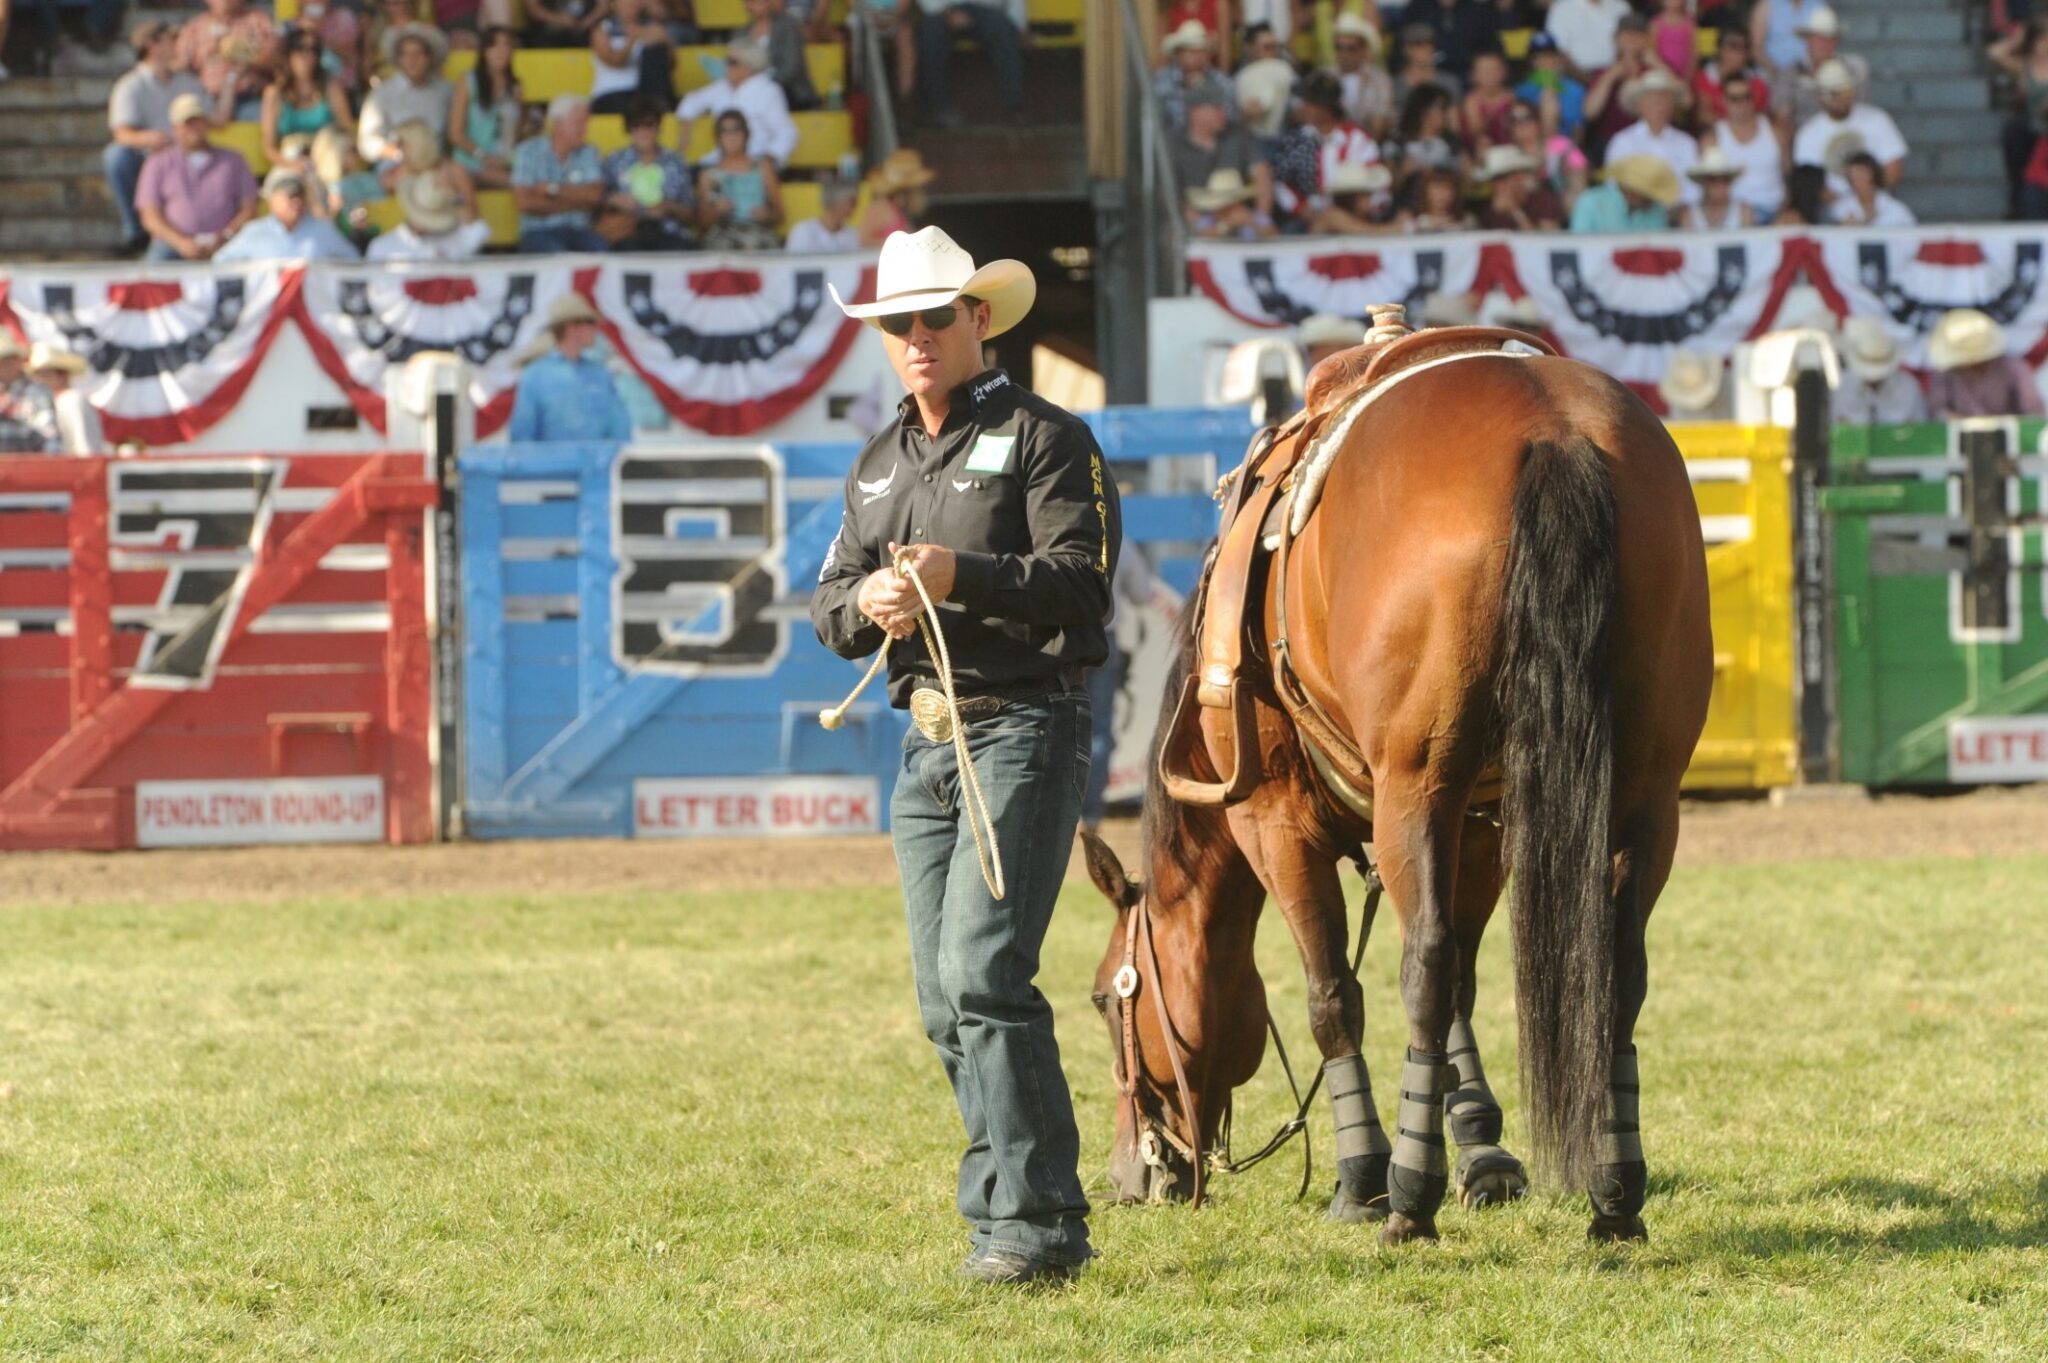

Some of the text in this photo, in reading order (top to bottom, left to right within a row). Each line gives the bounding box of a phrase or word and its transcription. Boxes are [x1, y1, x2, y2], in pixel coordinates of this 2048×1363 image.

[107, 459, 290, 691] 7
[611, 444, 792, 678] 8
[1947, 416, 2048, 643] 1
[142, 791, 378, 828] PENDLETON ROUND-UP
[636, 793, 871, 828] LET'ER BUCK
